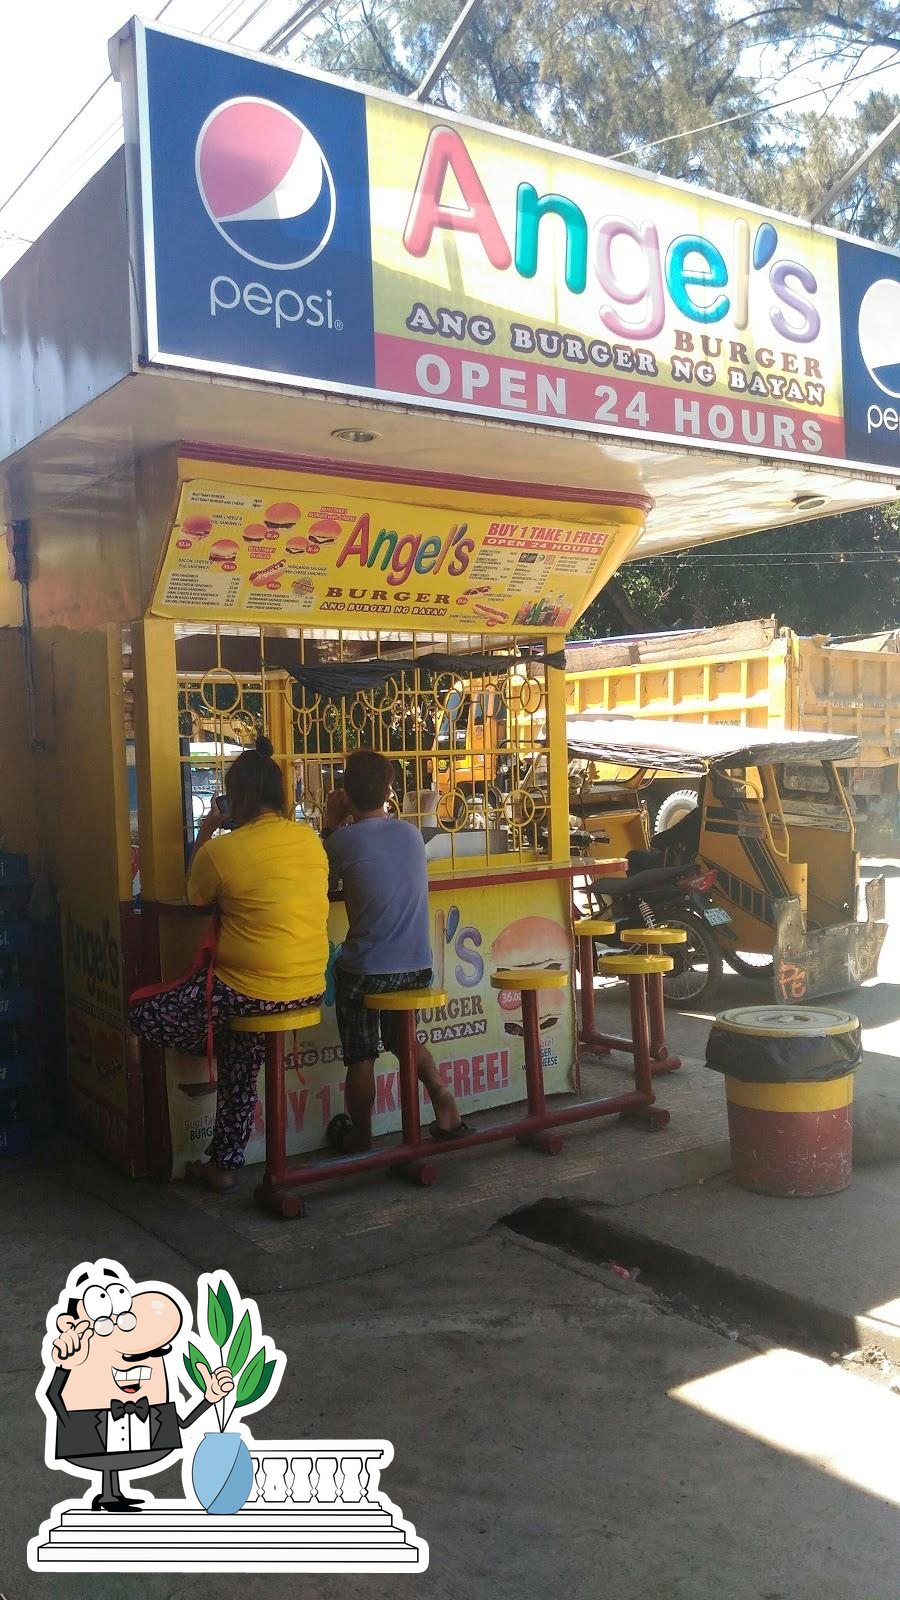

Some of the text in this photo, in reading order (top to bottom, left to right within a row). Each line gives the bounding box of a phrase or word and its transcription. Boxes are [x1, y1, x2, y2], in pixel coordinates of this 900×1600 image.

[403, 124, 821, 343] Angel's
[210, 276, 333, 329] pepsi
[406, 303, 825, 407] ANG BURGER NG BAYAN
[673, 330, 823, 379] BURGER
[415, 353, 823, 452] OPEN 24 HOURS
[335, 512, 475, 586] Angel's
[487, 522, 609, 545] BUY 1 TAKE 1 FREE!
[487, 539, 526, 547] OPEN
[552, 543, 599, 553] HOURS
[320, 602, 345, 610] ANG
[347, 603, 391, 613] BURGER
[393, 606, 410, 614] NG
[325, 587, 450, 604] BURGER
[416, 995, 484, 1024] URGER
[431, 1019, 487, 1043] BAYAN
